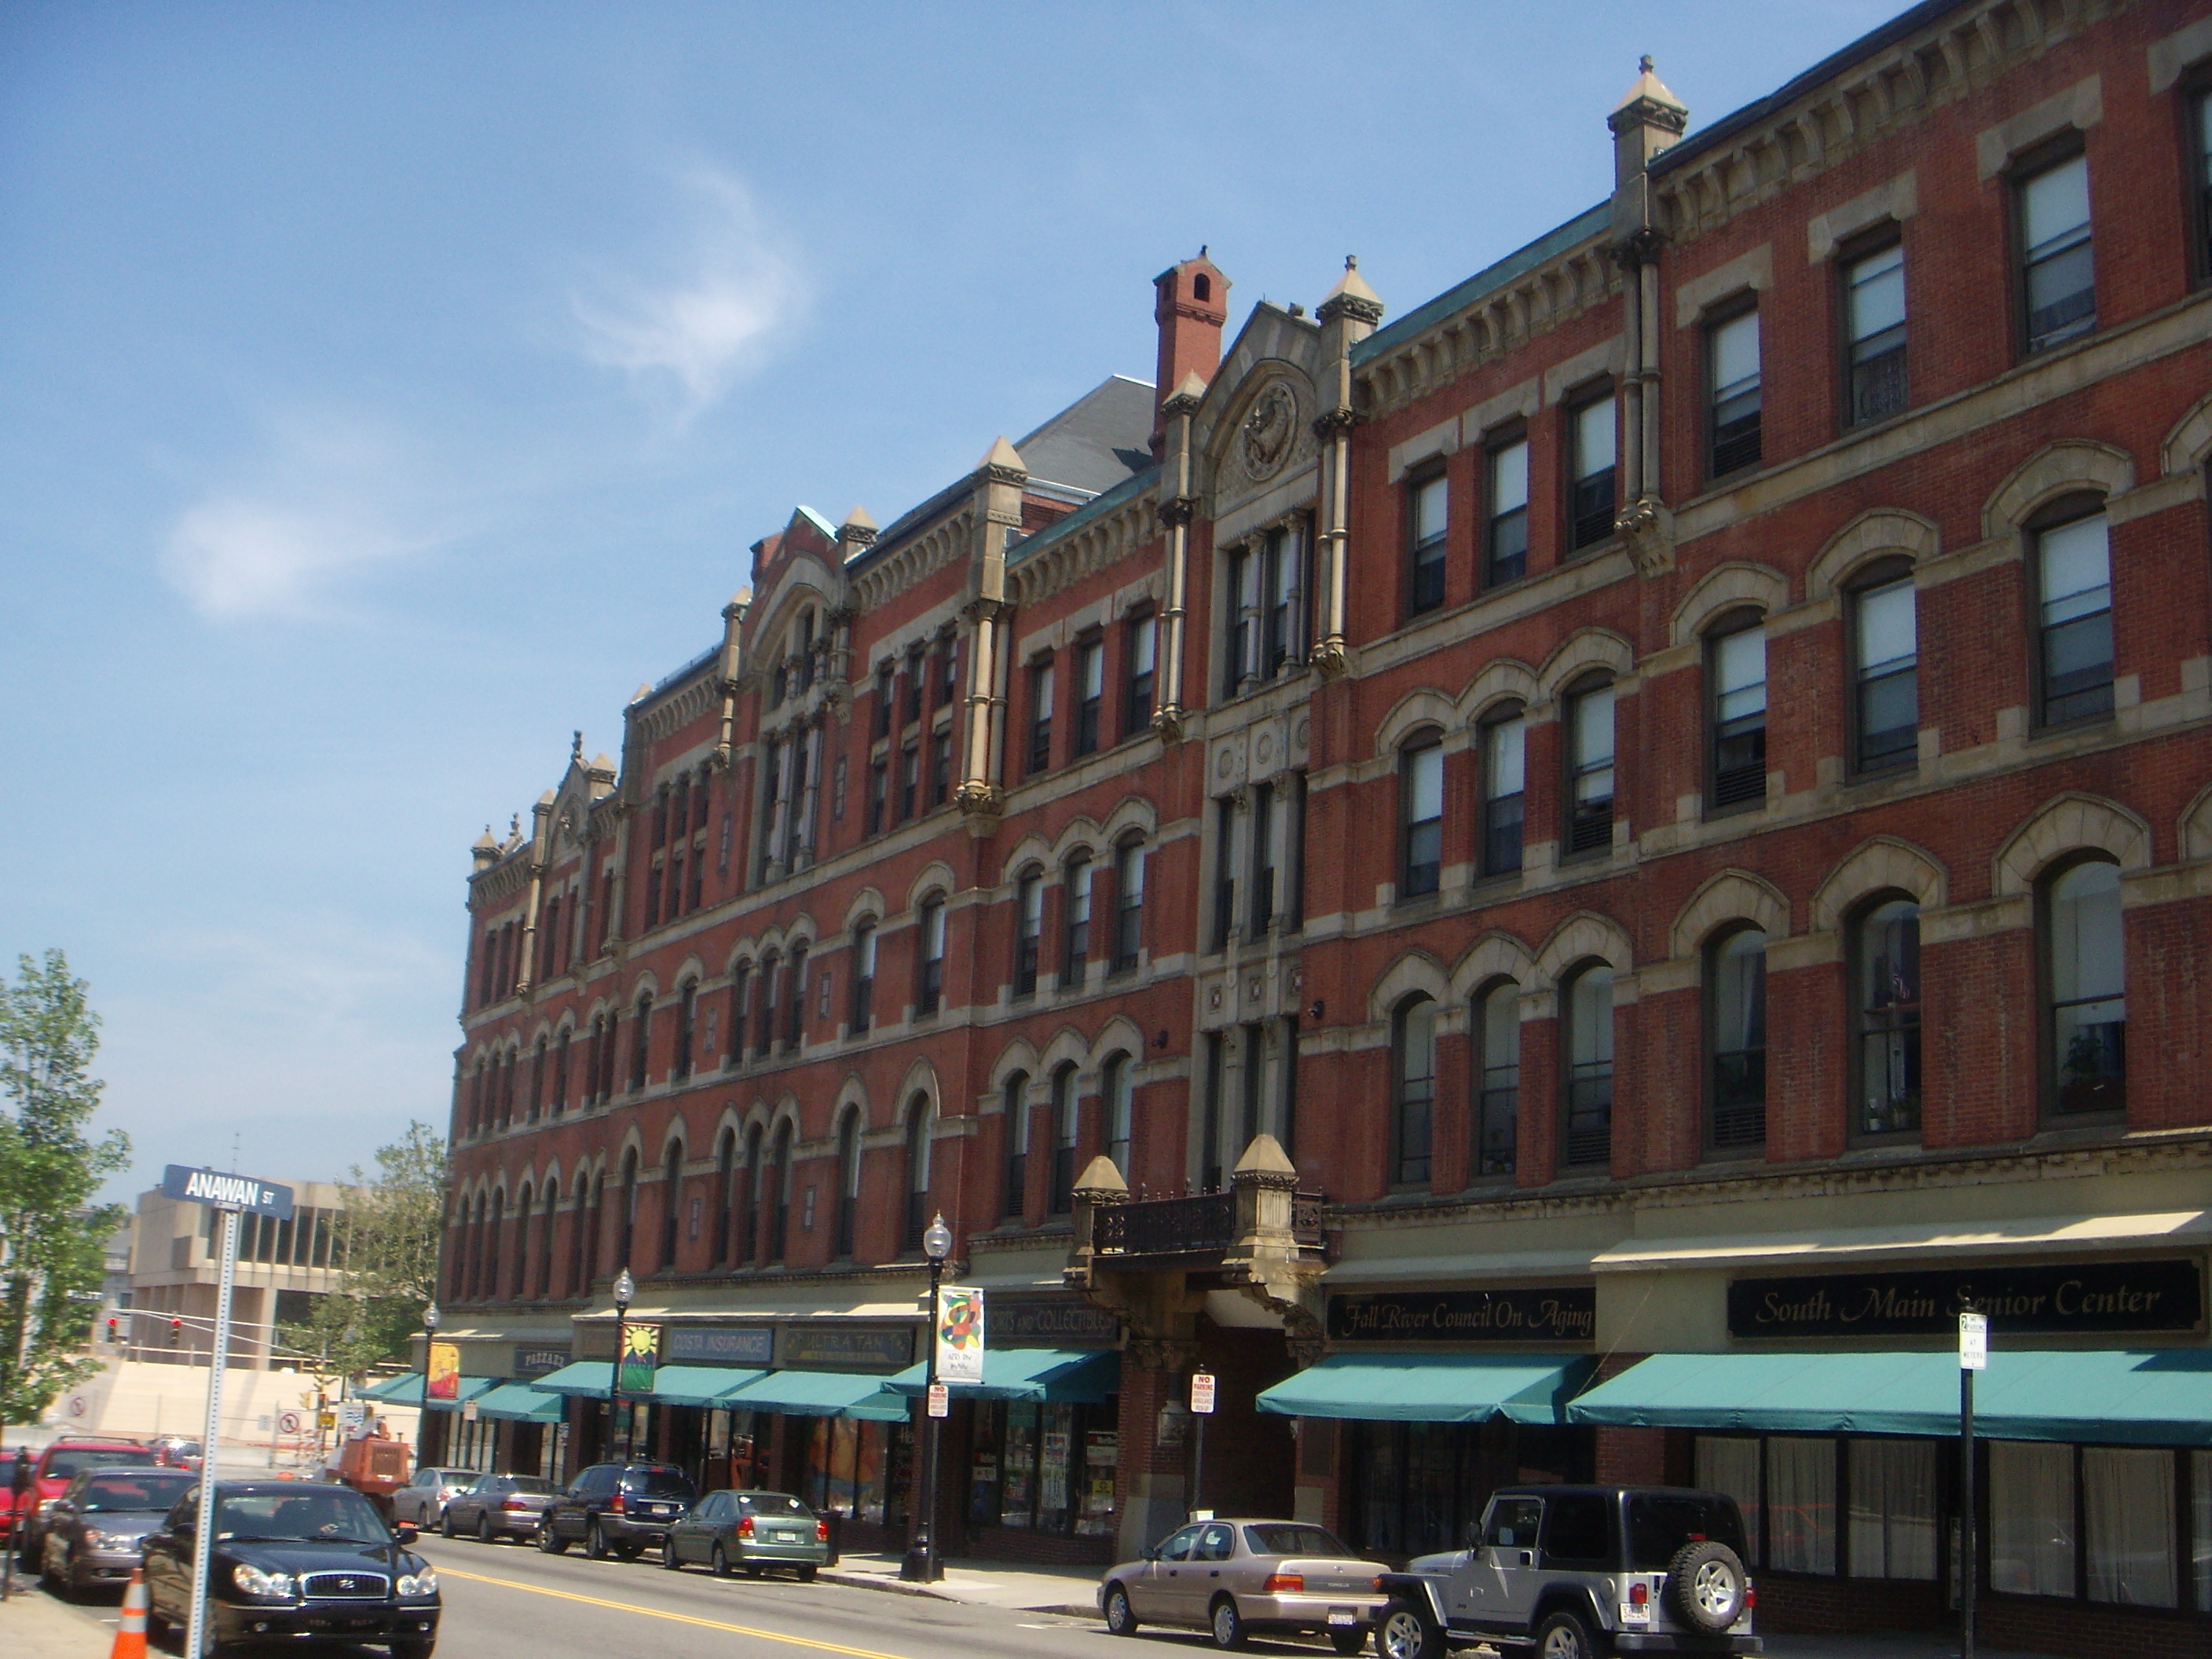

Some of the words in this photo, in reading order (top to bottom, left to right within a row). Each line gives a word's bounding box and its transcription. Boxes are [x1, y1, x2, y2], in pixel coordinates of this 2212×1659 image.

[185, 1173, 258, 1206] ANAWAN
[262, 1190, 274, 1204] ST
[1341, 1304, 1379, 1336] Fall
[1381, 1304, 1429, 1331] River
[1432, 1302, 1491, 1328] Council
[1496, 1301, 1522, 1328] On
[1527, 1299, 1592, 1336] Aging
[1755, 1289, 1831, 1323] South
[1839, 1287, 1936, 1321] Main
[1946, 1284, 2046, 1317] Senior
[2056, 1280, 2161, 1315] Center
[706, 1335, 766, 1353] INSURANCE
